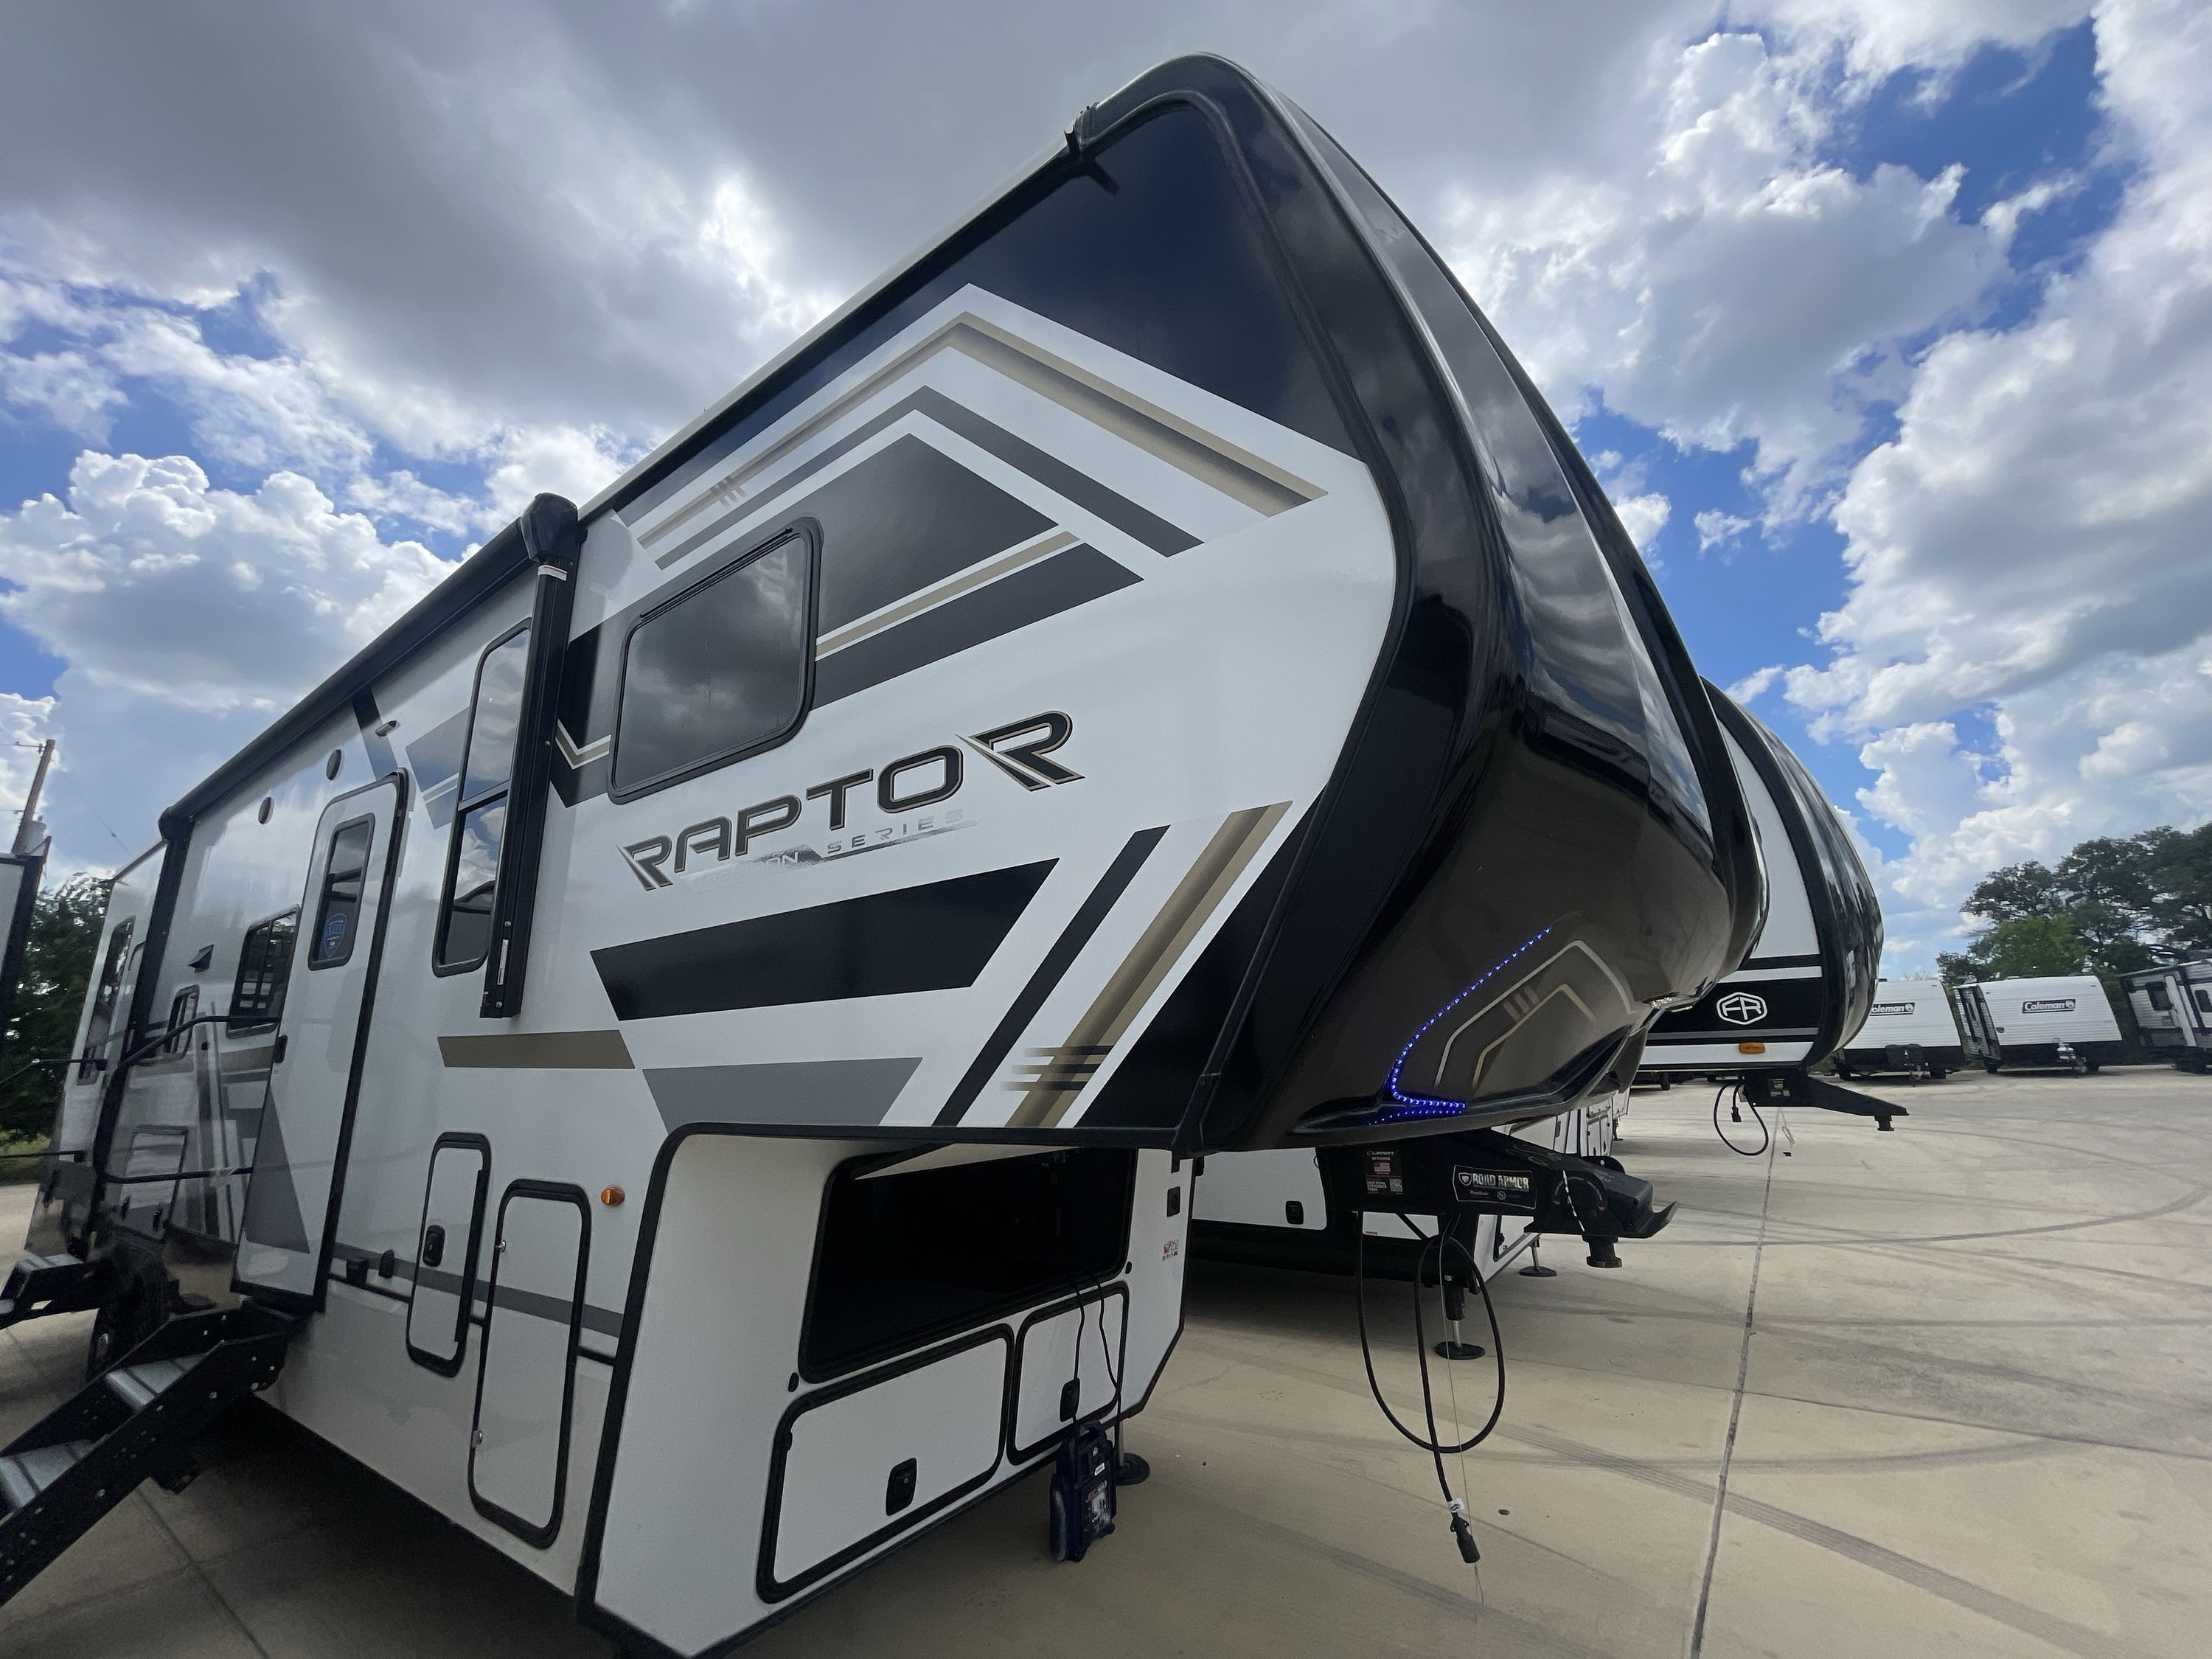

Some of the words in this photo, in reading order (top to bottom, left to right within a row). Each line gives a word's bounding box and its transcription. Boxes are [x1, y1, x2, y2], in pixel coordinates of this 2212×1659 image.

[616, 710, 1085, 891] RAPTOR
[827, 807, 964, 854] SERIES
[1871, 1004, 1905, 1013] oleman
[2024, 1001, 2065, 1011] Coleman
[1472, 1173, 1496, 1186] ROAD
[1498, 1175, 1530, 1190] ARMOR
